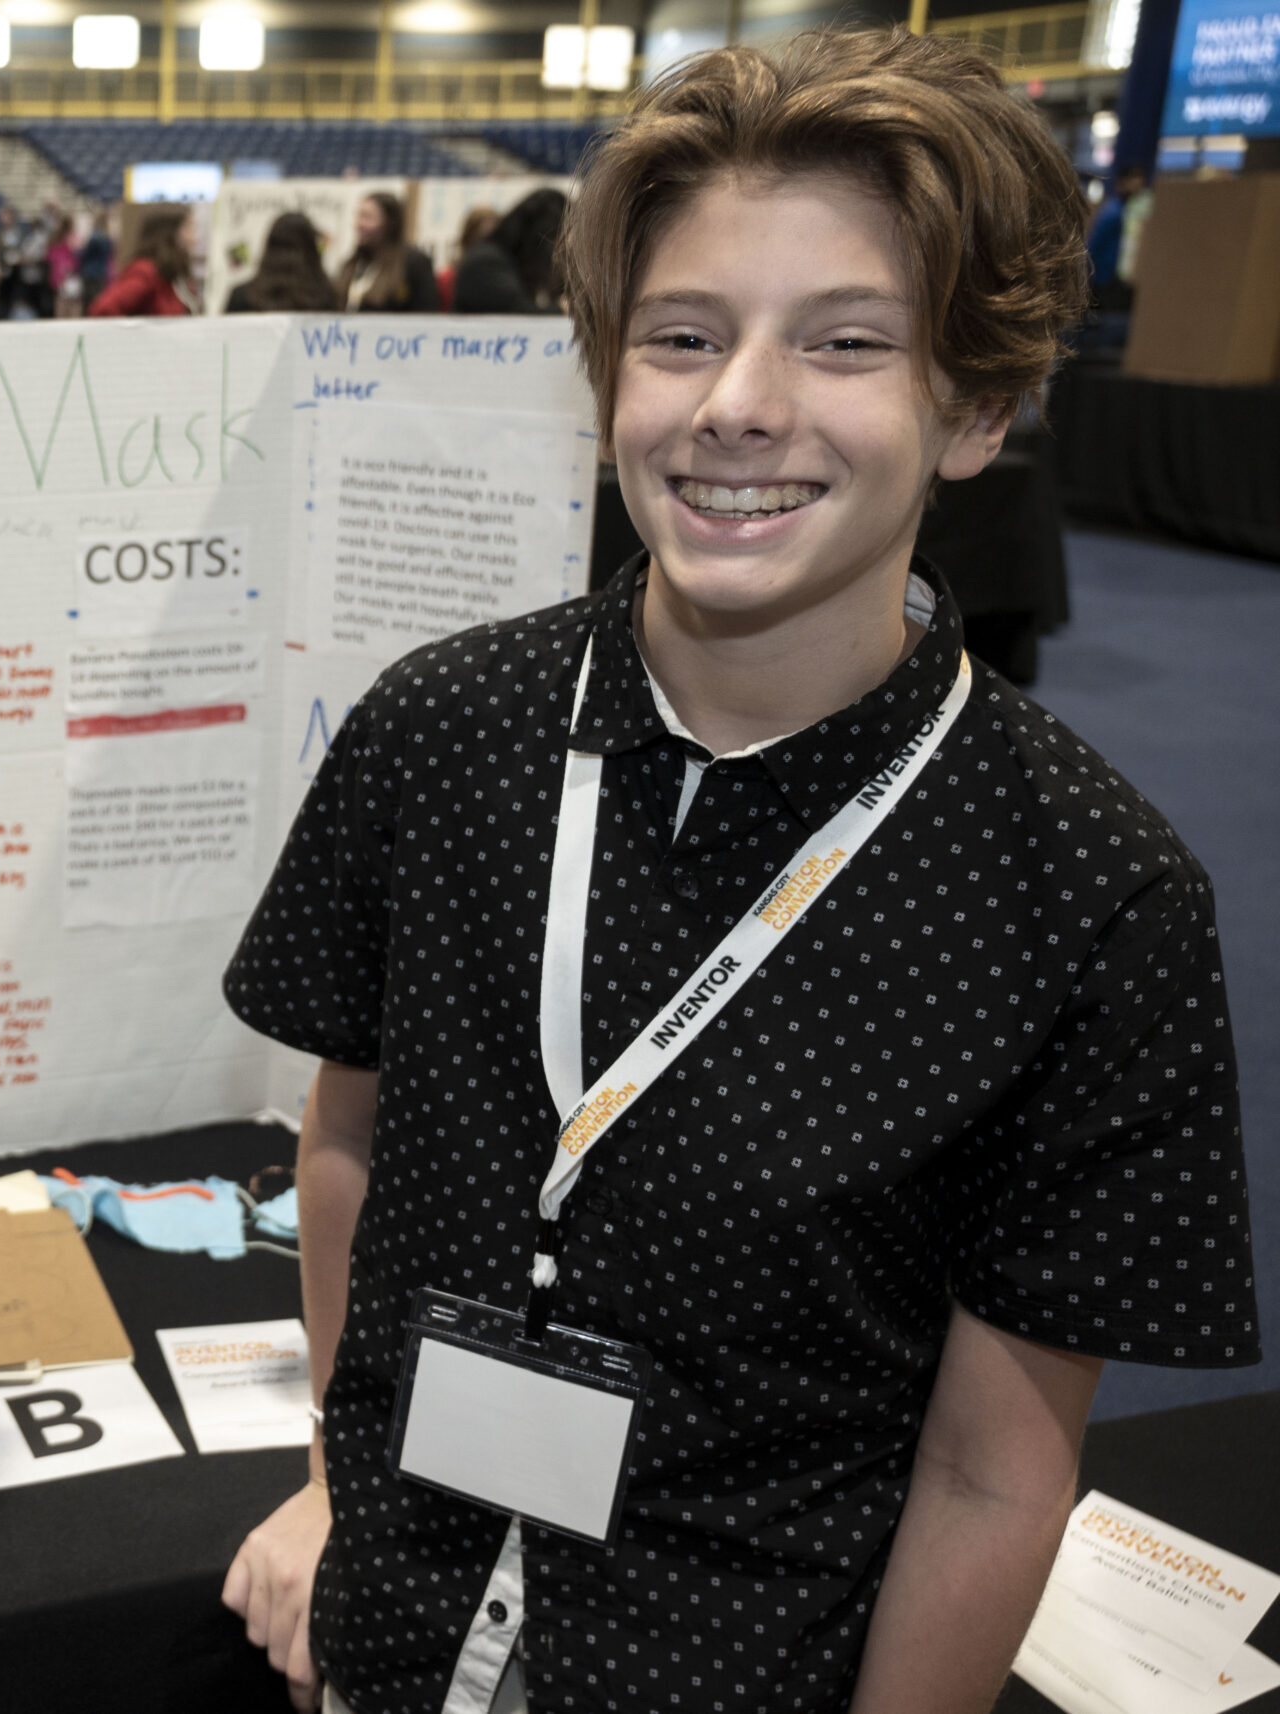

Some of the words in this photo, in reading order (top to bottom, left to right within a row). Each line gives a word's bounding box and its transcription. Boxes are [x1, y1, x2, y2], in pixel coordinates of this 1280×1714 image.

[302, 321, 359, 365] Why
[375, 334, 427, 361] our
[442, 334, 530, 363] mask's
[314, 373, 379, 401] better
[389, 458, 435, 479] friendly
[439, 465, 461, 480] and
[406, 482, 435, 495] Even
[439, 484, 483, 502] though
[513, 492, 536, 506] Eco
[394, 520, 440, 537] Doctors
[444, 528, 465, 540] can
[468, 531, 490, 543] use
[493, 531, 518, 546] this
[468, 510, 514, 525] against
[85, 538, 241, 584] COSTS:
[337, 534, 367, 547] mask
[371, 536, 386, 551] for
[450, 546, 474, 561] Our
[477, 551, 517, 567] masks
[376, 558, 405, 573] good
[409, 561, 431, 576] and
[491, 569, 514, 586] but
[753, 888, 779, 917] KANSAS
[775, 872, 790, 890] CITY
[759, 854, 823, 924] INVENTION
[772, 848, 847, 930] CONVENTION
[650, 955, 742, 1051] INVENTOR
[560, 1086, 615, 1149] INVENTION
[568, 1081, 638, 1156] CONVENTION
[573, 1102, 587, 1117] CITY
[174, 1341, 273, 1357] INVENTION
[176, 1349, 300, 1367] CONVENTION
[4, 1388, 104, 1459] B
[1080, 1518, 1247, 1602] CONVENTION
[1086, 1510, 1222, 1579] INVENTION
[1070, 1531, 1167, 1581] Convention's
[1171, 1578, 1227, 1611] Choice
[1092, 1555, 1141, 1583] Award
[1145, 1580, 1190, 1607] Ballot
